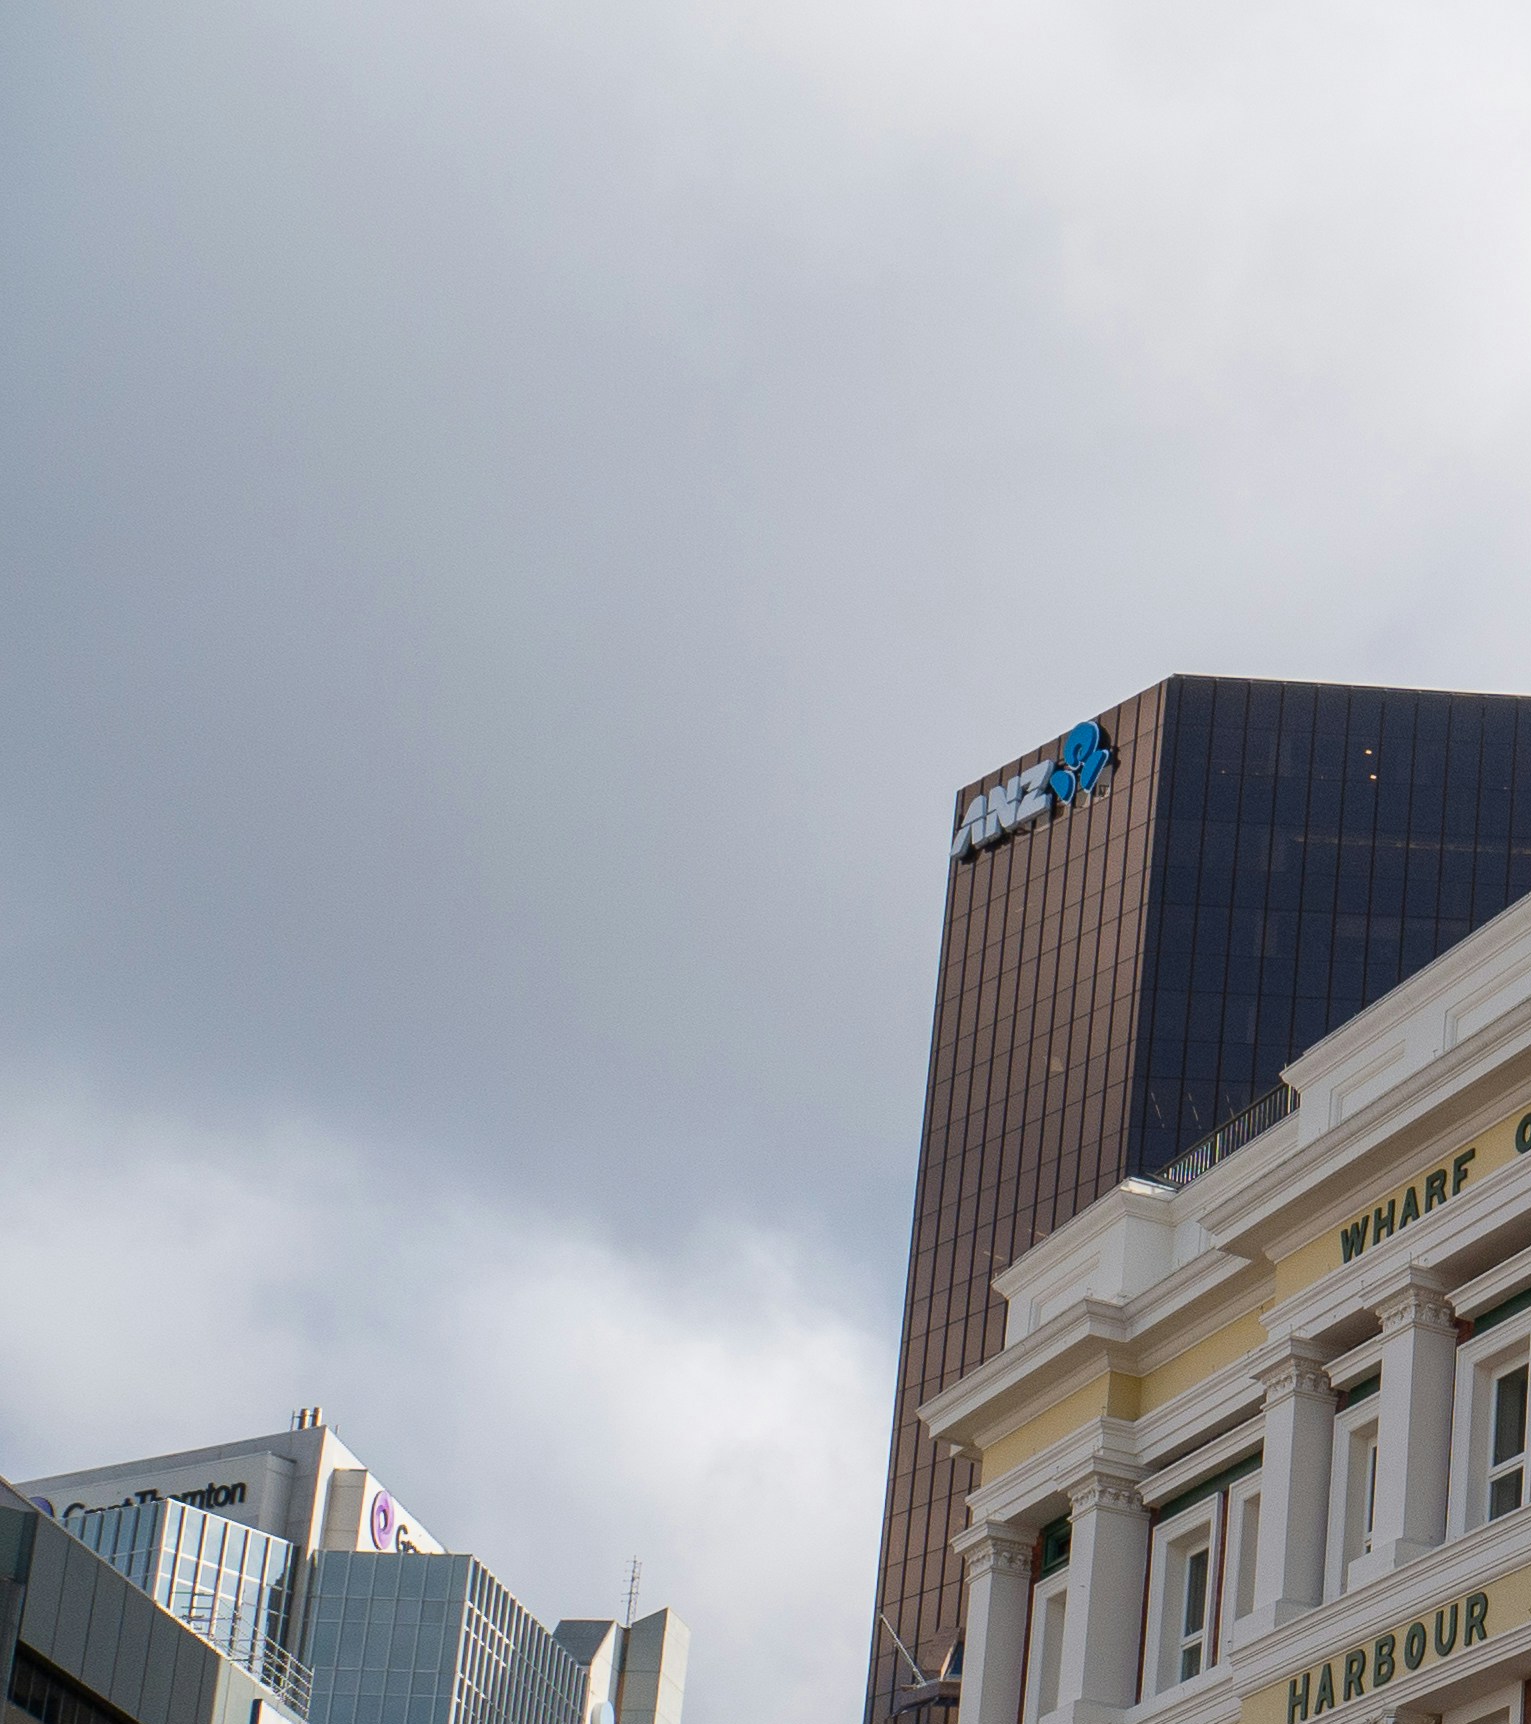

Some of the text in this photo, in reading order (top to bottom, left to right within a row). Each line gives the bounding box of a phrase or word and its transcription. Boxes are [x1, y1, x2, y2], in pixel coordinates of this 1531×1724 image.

[950, 759, 1057, 859] ANZ
[1340, 1148, 1476, 1264] WHARF
[134, 1482, 247, 1509] Thrnton
